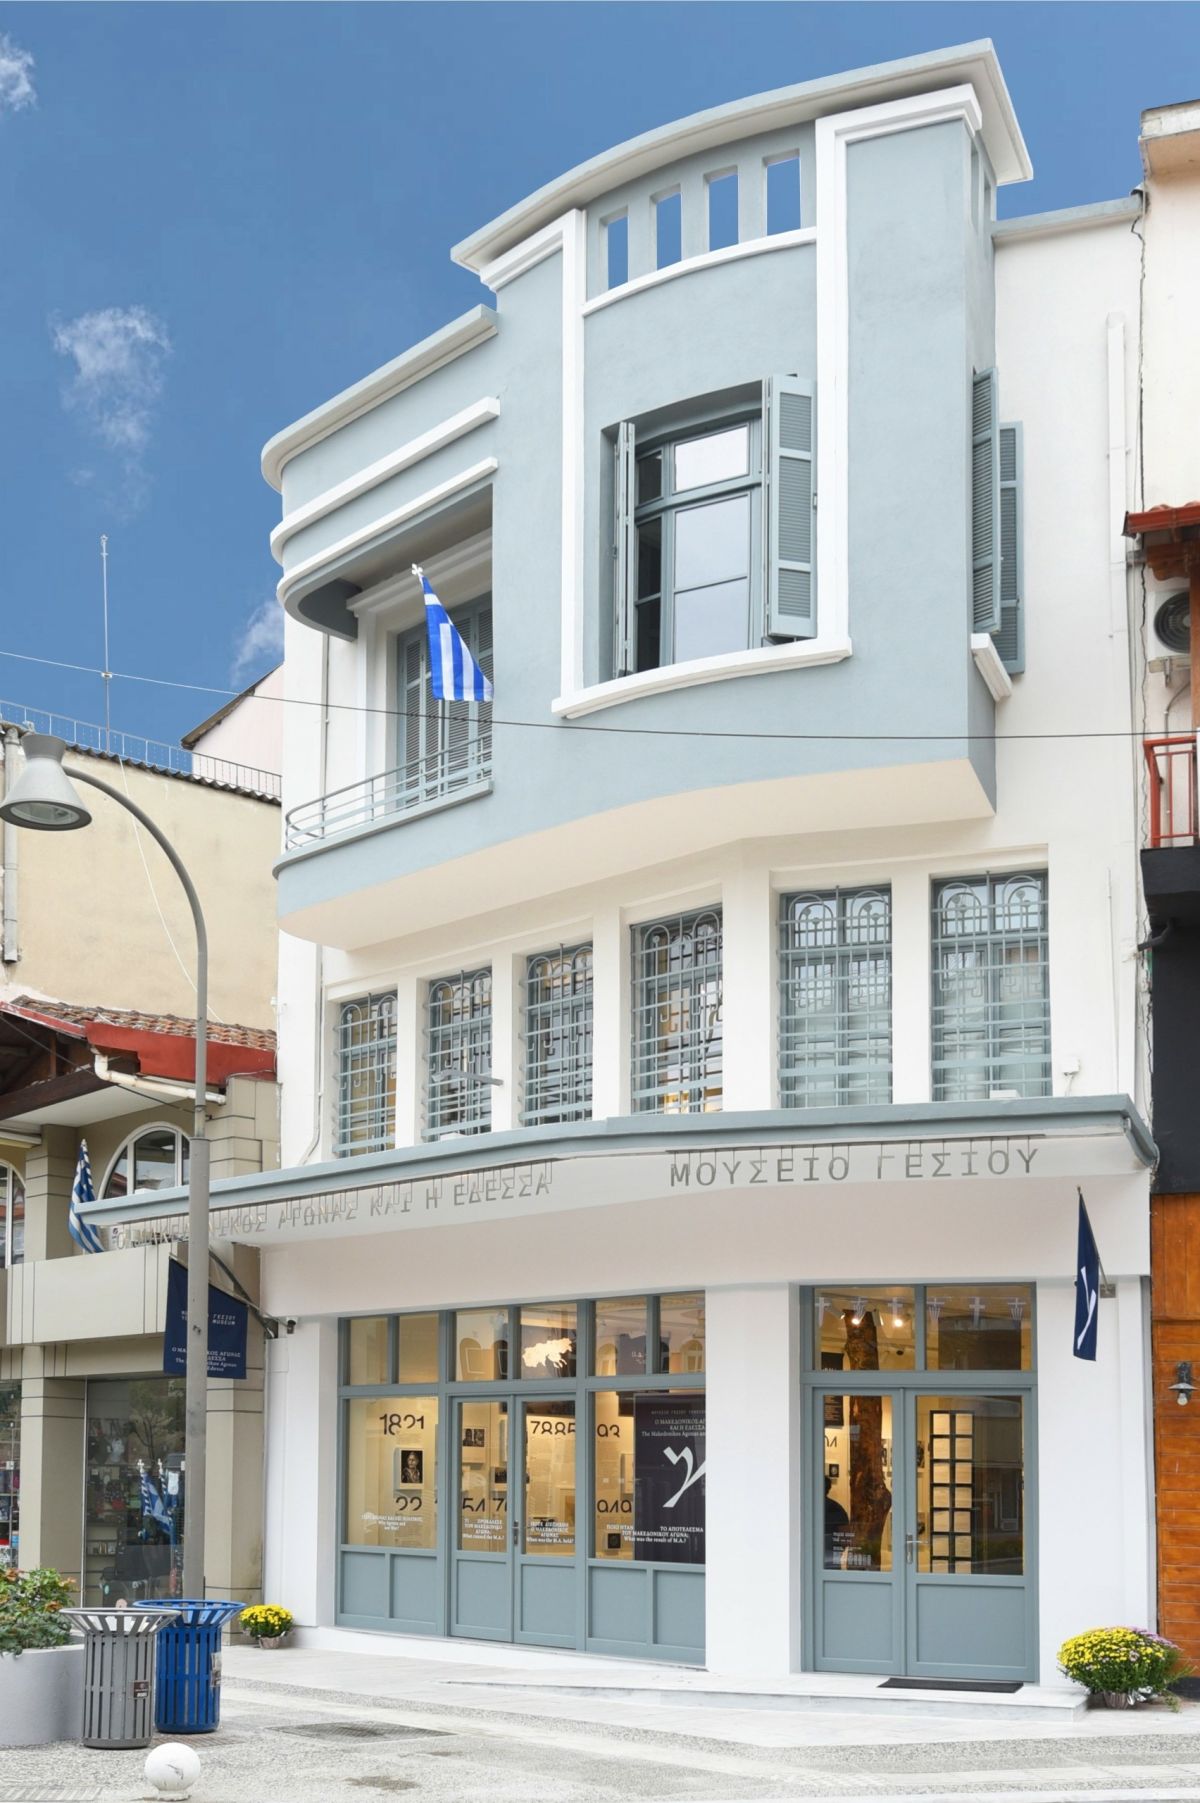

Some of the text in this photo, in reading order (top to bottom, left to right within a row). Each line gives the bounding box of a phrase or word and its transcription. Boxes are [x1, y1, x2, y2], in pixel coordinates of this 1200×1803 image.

[670, 1148, 1039, 1187] ΜΟΥΣΕΙΟ ΓΕΣΙΟΥ
[454, 1173, 550, 1206] ΕΔΕΣΣΑ
